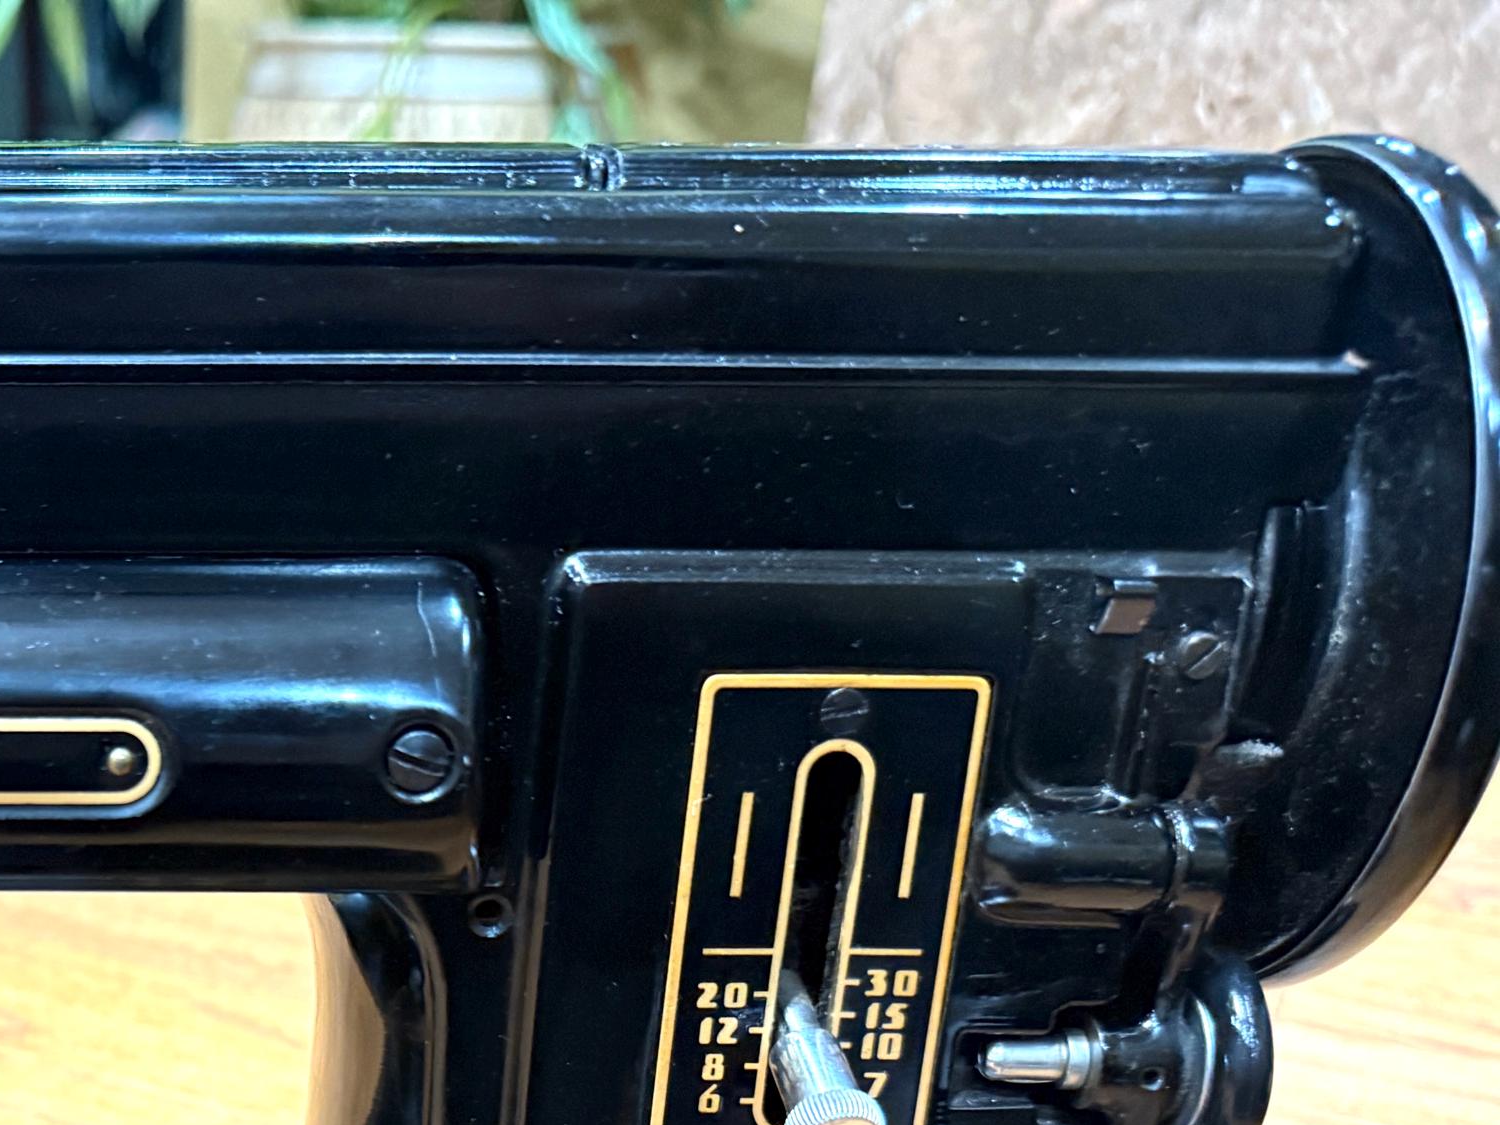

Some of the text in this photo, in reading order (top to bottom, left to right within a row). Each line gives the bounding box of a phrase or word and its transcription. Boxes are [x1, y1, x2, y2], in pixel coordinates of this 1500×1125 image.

[696, 981, 748, 1009] 20
[864, 968, 919, 998] 30
[698, 1016, 739, 1045] 12
[865, 1002, 909, 1030] 15
[860, 1032, 903, 1061] 10
[702, 1052, 725, 1081] 8
[698, 1083, 721, 1114] 6
[864, 1071, 889, 1099] 7
